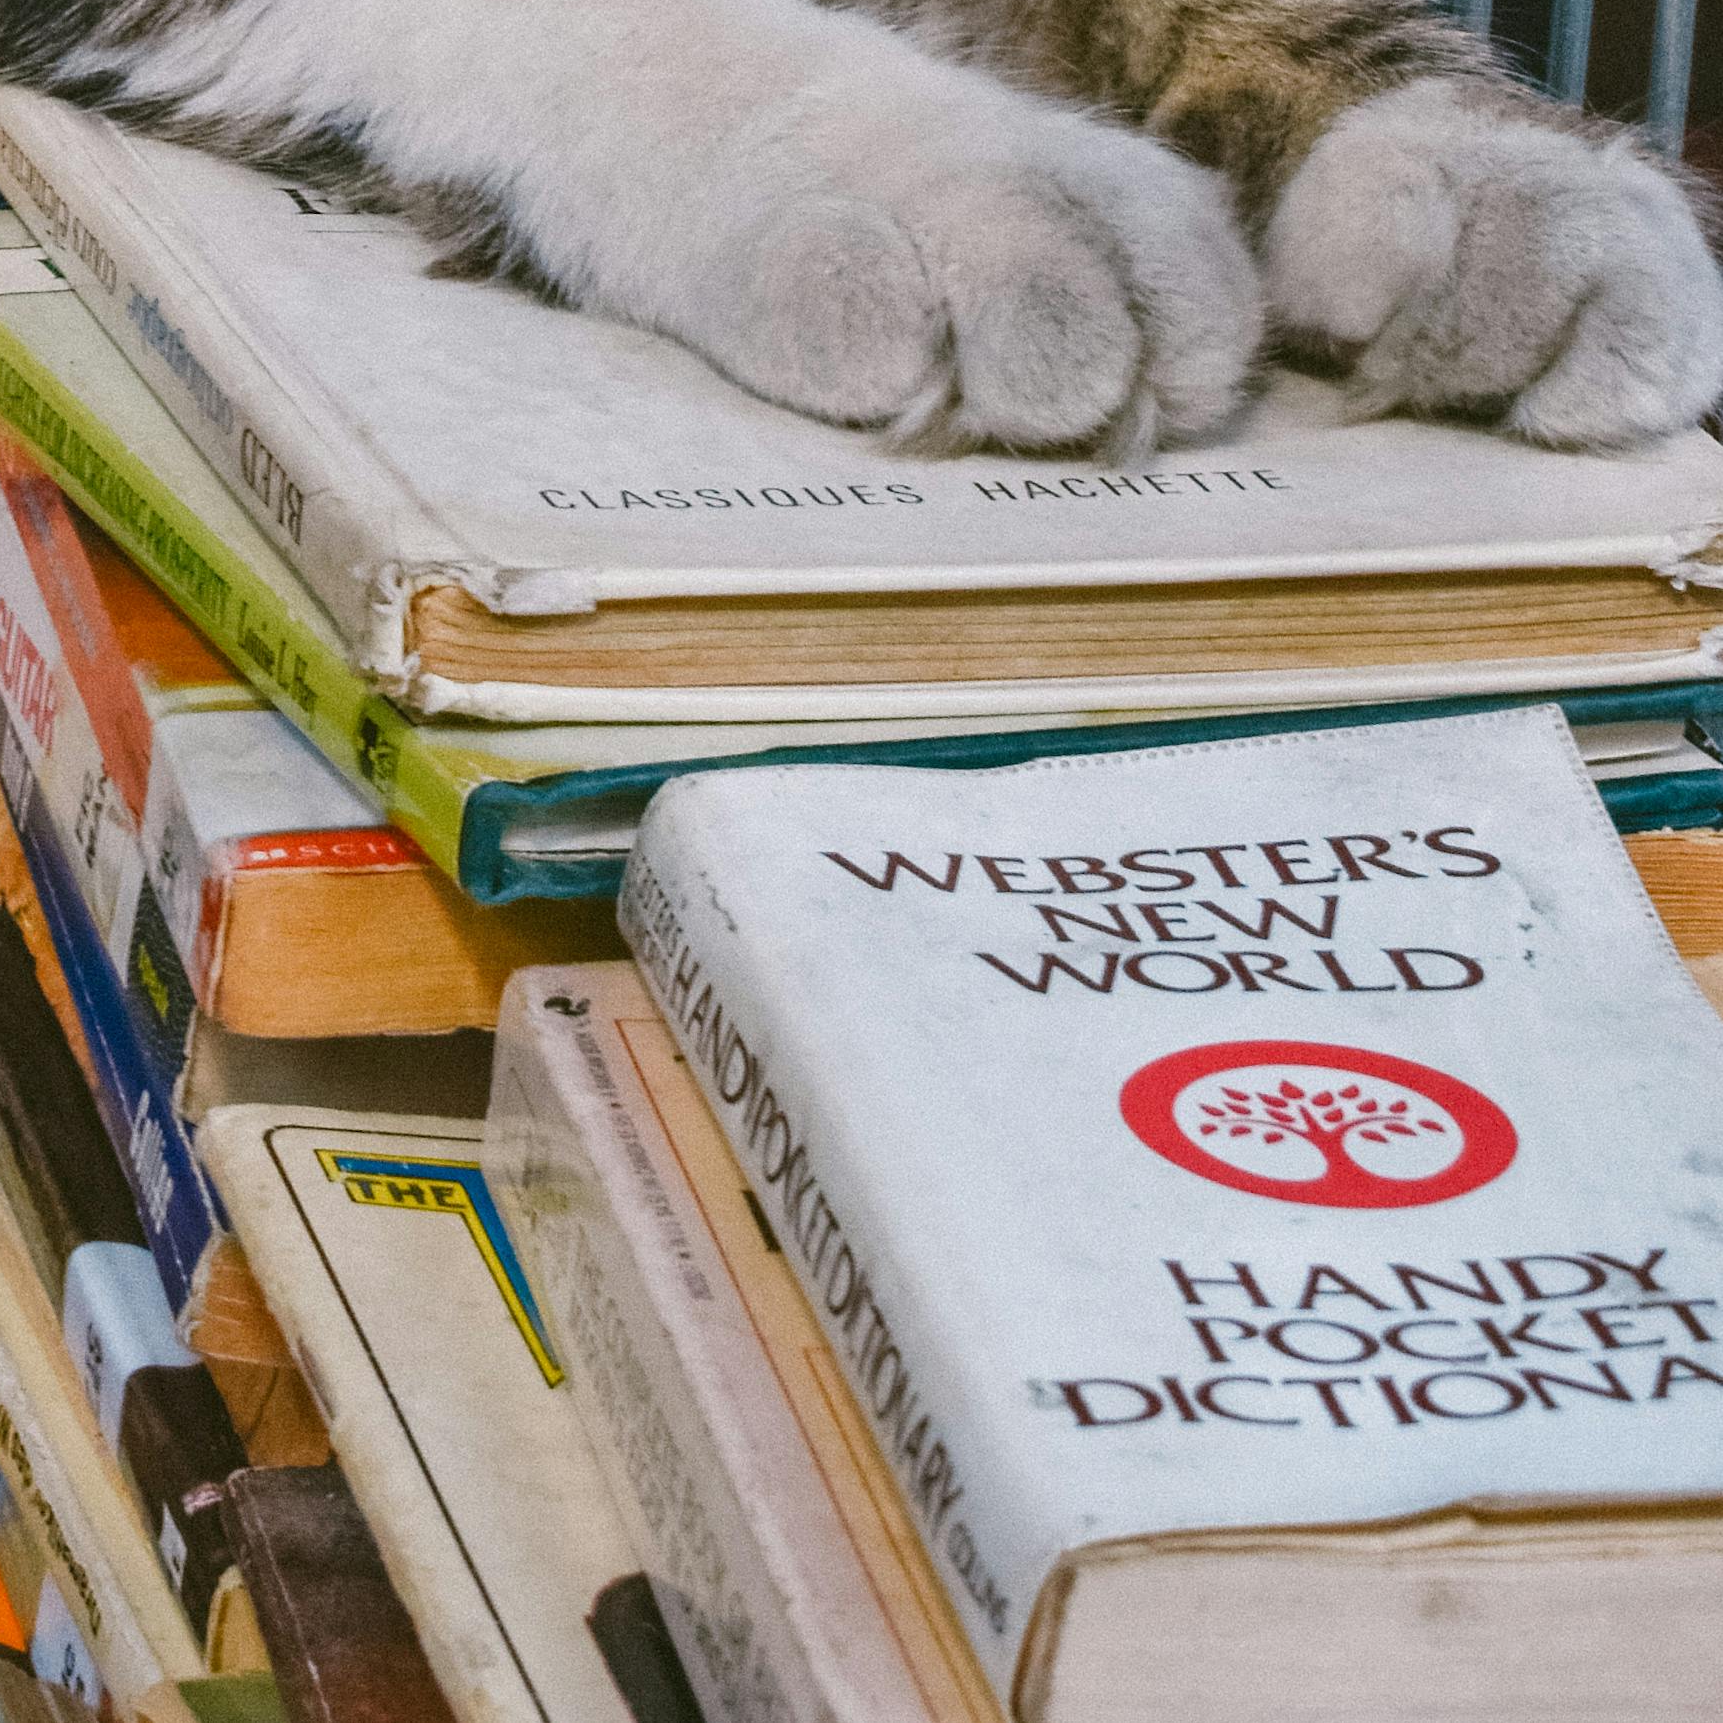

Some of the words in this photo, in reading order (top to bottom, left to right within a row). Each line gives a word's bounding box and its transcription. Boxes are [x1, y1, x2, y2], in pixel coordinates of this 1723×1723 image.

[239, 426, 305, 546] BLED
[538, 482, 926, 512] CLASSIQUES
[971, 468, 1292, 504] HACHETTE
[821, 825, 1503, 898] WEBSTER'S
[1038, 894, 1342, 944] NEW
[975, 946, 1487, 995] WORLD
[344, 1176, 468, 1210] THE
[669, 944, 761, 1126] HANDY
[747, 1086, 841, 1281] POCKET
[825, 1238, 966, 1544] DICTIONARY
[1163, 1247, 1668, 1312] HANDY
[1189, 1299, 1717, 1365] POCKET
[1058, 1355, 1723, 1430] DICTIONA
